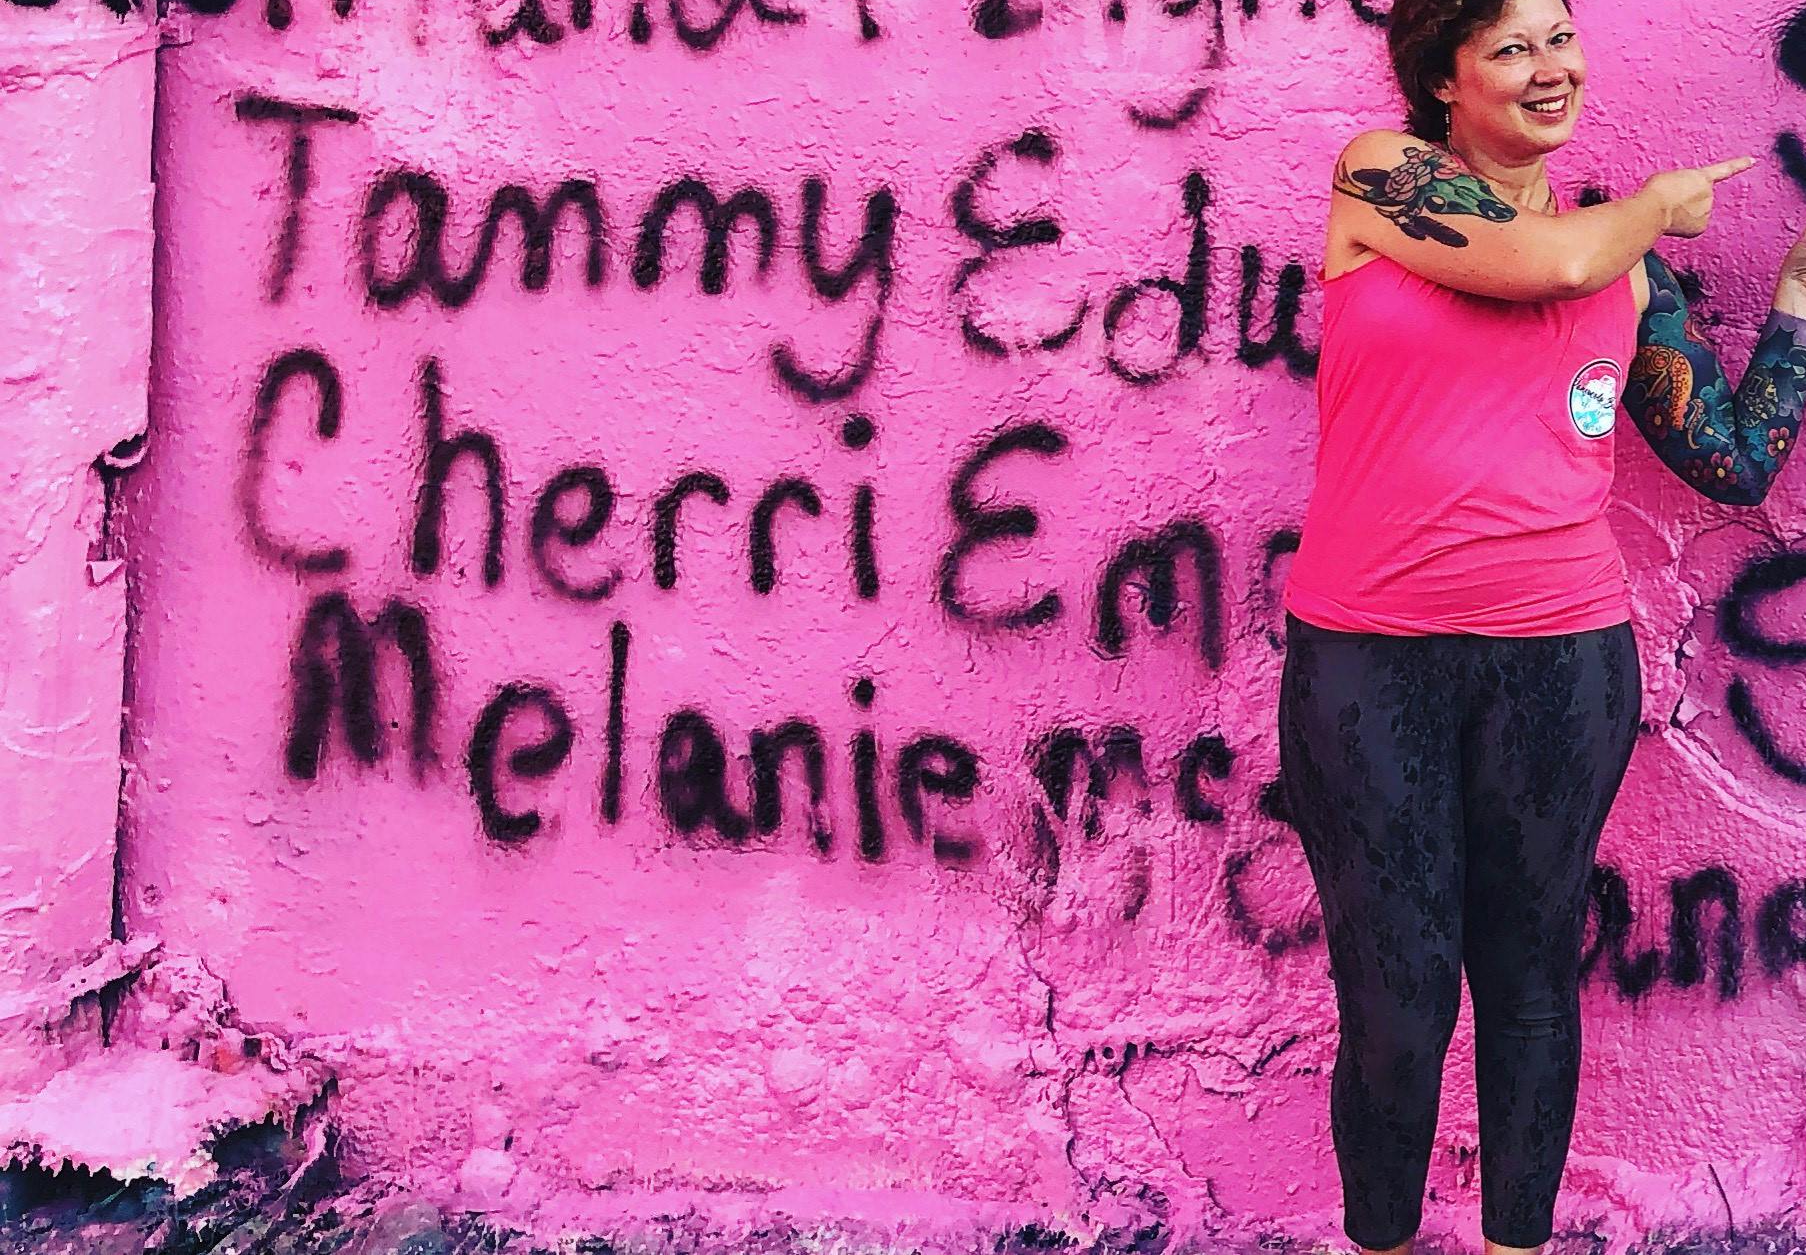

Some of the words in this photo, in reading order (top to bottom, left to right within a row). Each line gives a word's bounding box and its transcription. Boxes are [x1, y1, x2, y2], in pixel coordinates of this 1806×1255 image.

[236, 96, 897, 415] Tammy
[255, 350, 878, 607] Cherri
[287, 585, 979, 861] Melanie
